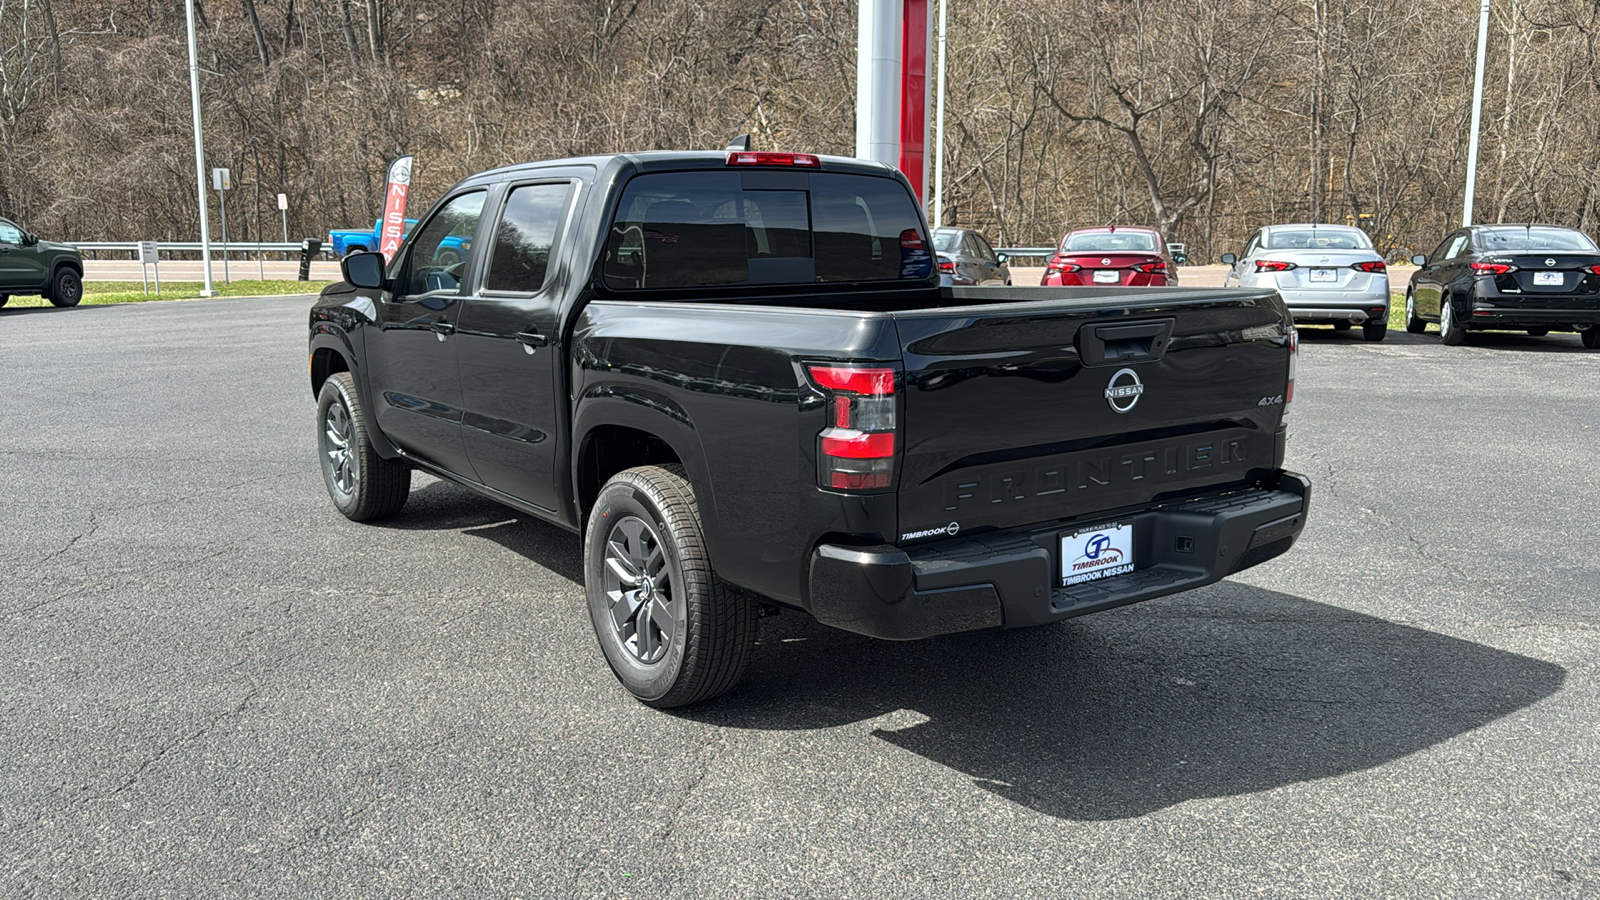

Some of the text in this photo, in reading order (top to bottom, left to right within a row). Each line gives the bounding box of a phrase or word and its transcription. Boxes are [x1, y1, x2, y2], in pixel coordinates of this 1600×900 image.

[1106, 386, 1143, 397] NISSAN
[944, 435, 1248, 512] FRONTIER
[901, 526, 947, 540] TIMBROOK
[1072, 555, 1120, 571] TIMBROOK
[1062, 563, 1135, 587] TIMBROOK NISSAN
